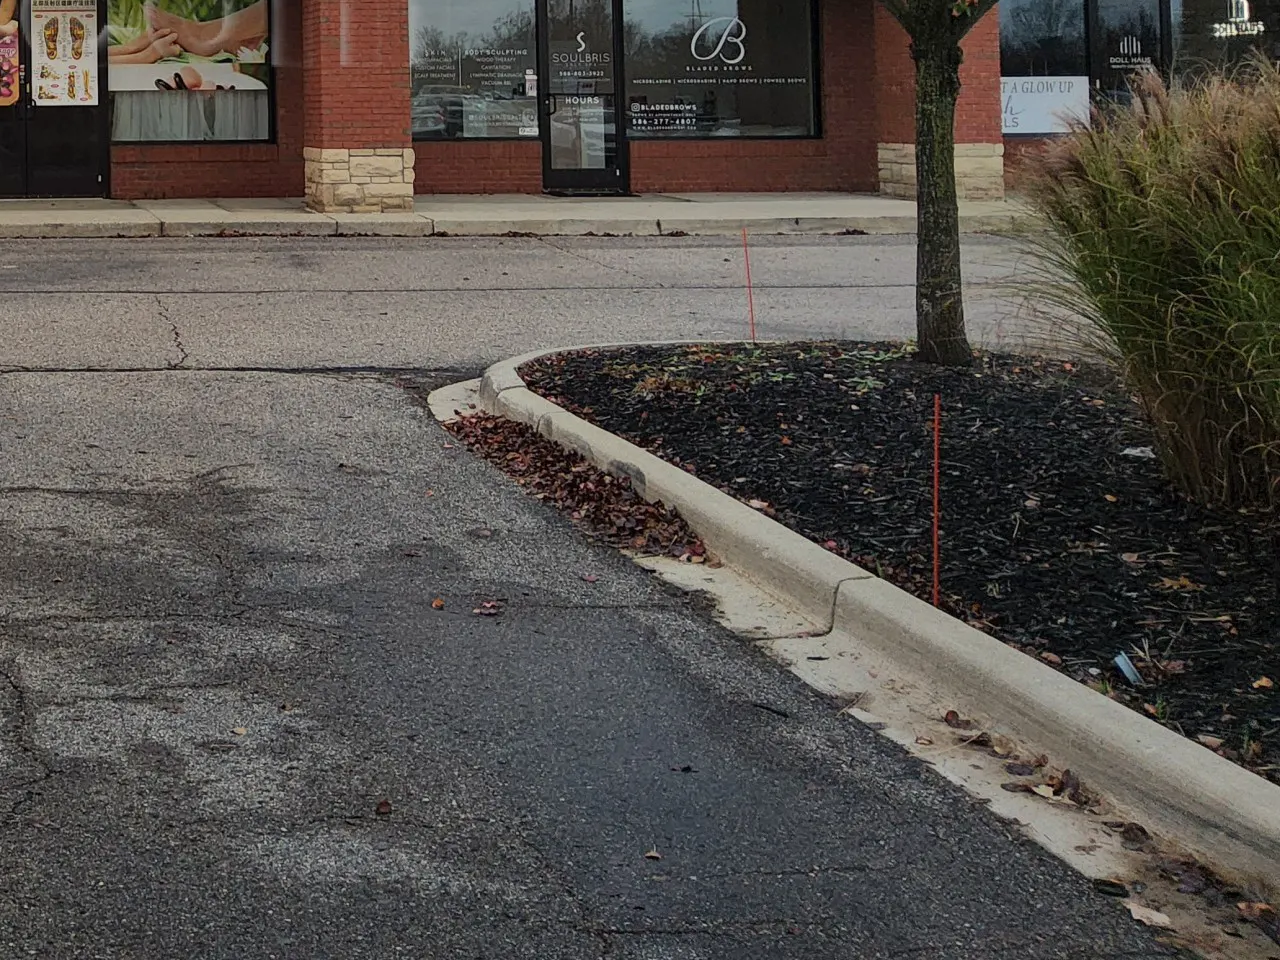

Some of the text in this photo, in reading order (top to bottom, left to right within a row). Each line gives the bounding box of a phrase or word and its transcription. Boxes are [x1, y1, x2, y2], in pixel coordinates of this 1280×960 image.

[690, 16, 747, 64] B
[552, 53, 611, 63] SOULBRIS
[1011, 82, 1018, 94] A
[1021, 81, 1056, 94] GLOW
[1059, 81, 1074, 93] UP
[565, 96, 600, 104] HOURS
